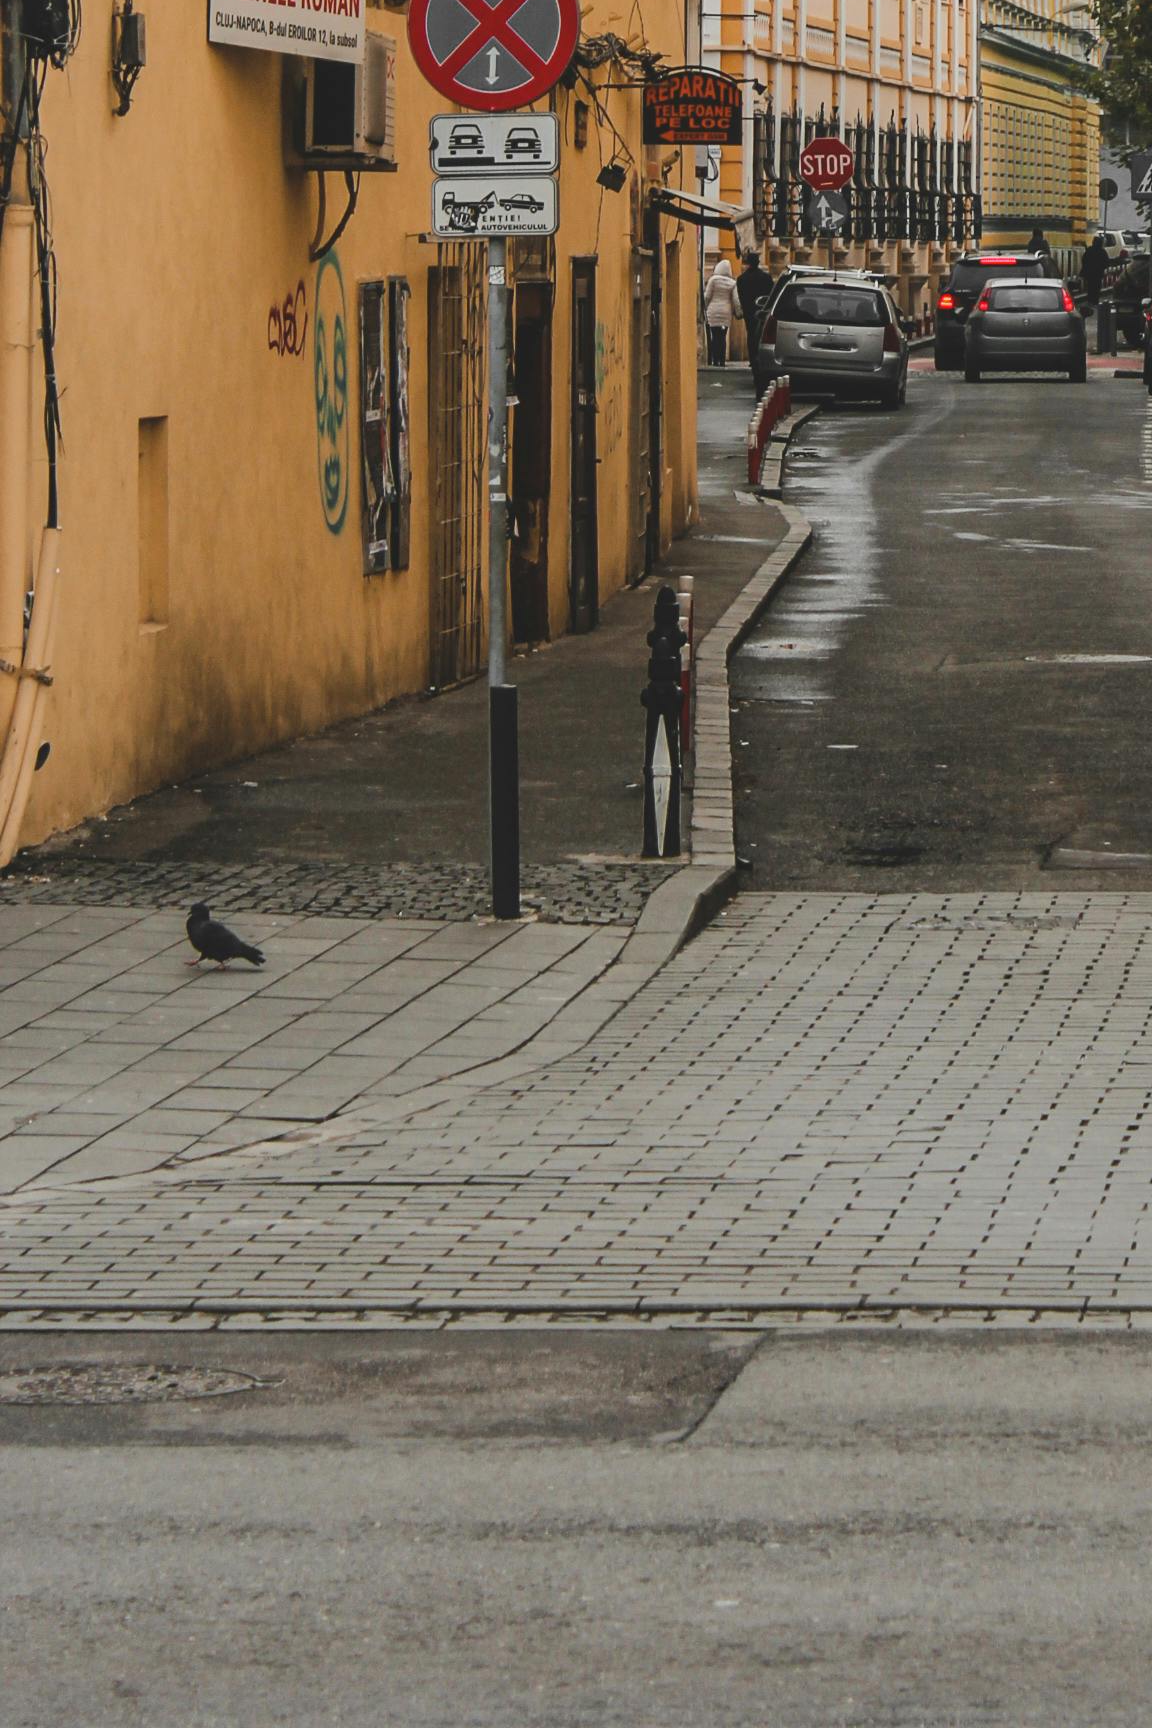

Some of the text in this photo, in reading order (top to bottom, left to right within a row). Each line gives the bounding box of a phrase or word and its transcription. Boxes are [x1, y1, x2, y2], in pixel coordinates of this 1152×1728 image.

[215, 11, 268, 37] CLUJ-NAPOCA,
[269, 21, 287, 37] B-dul
[288, 23, 317, 43] EROILOR
[318, 29, 328, 47] 12,
[337, 33, 358, 48] subsol
[655, 104, 732, 118] TELEFOANE
[655, 118, 731, 129] PE LOC
[803, 154, 851, 176] STOP
